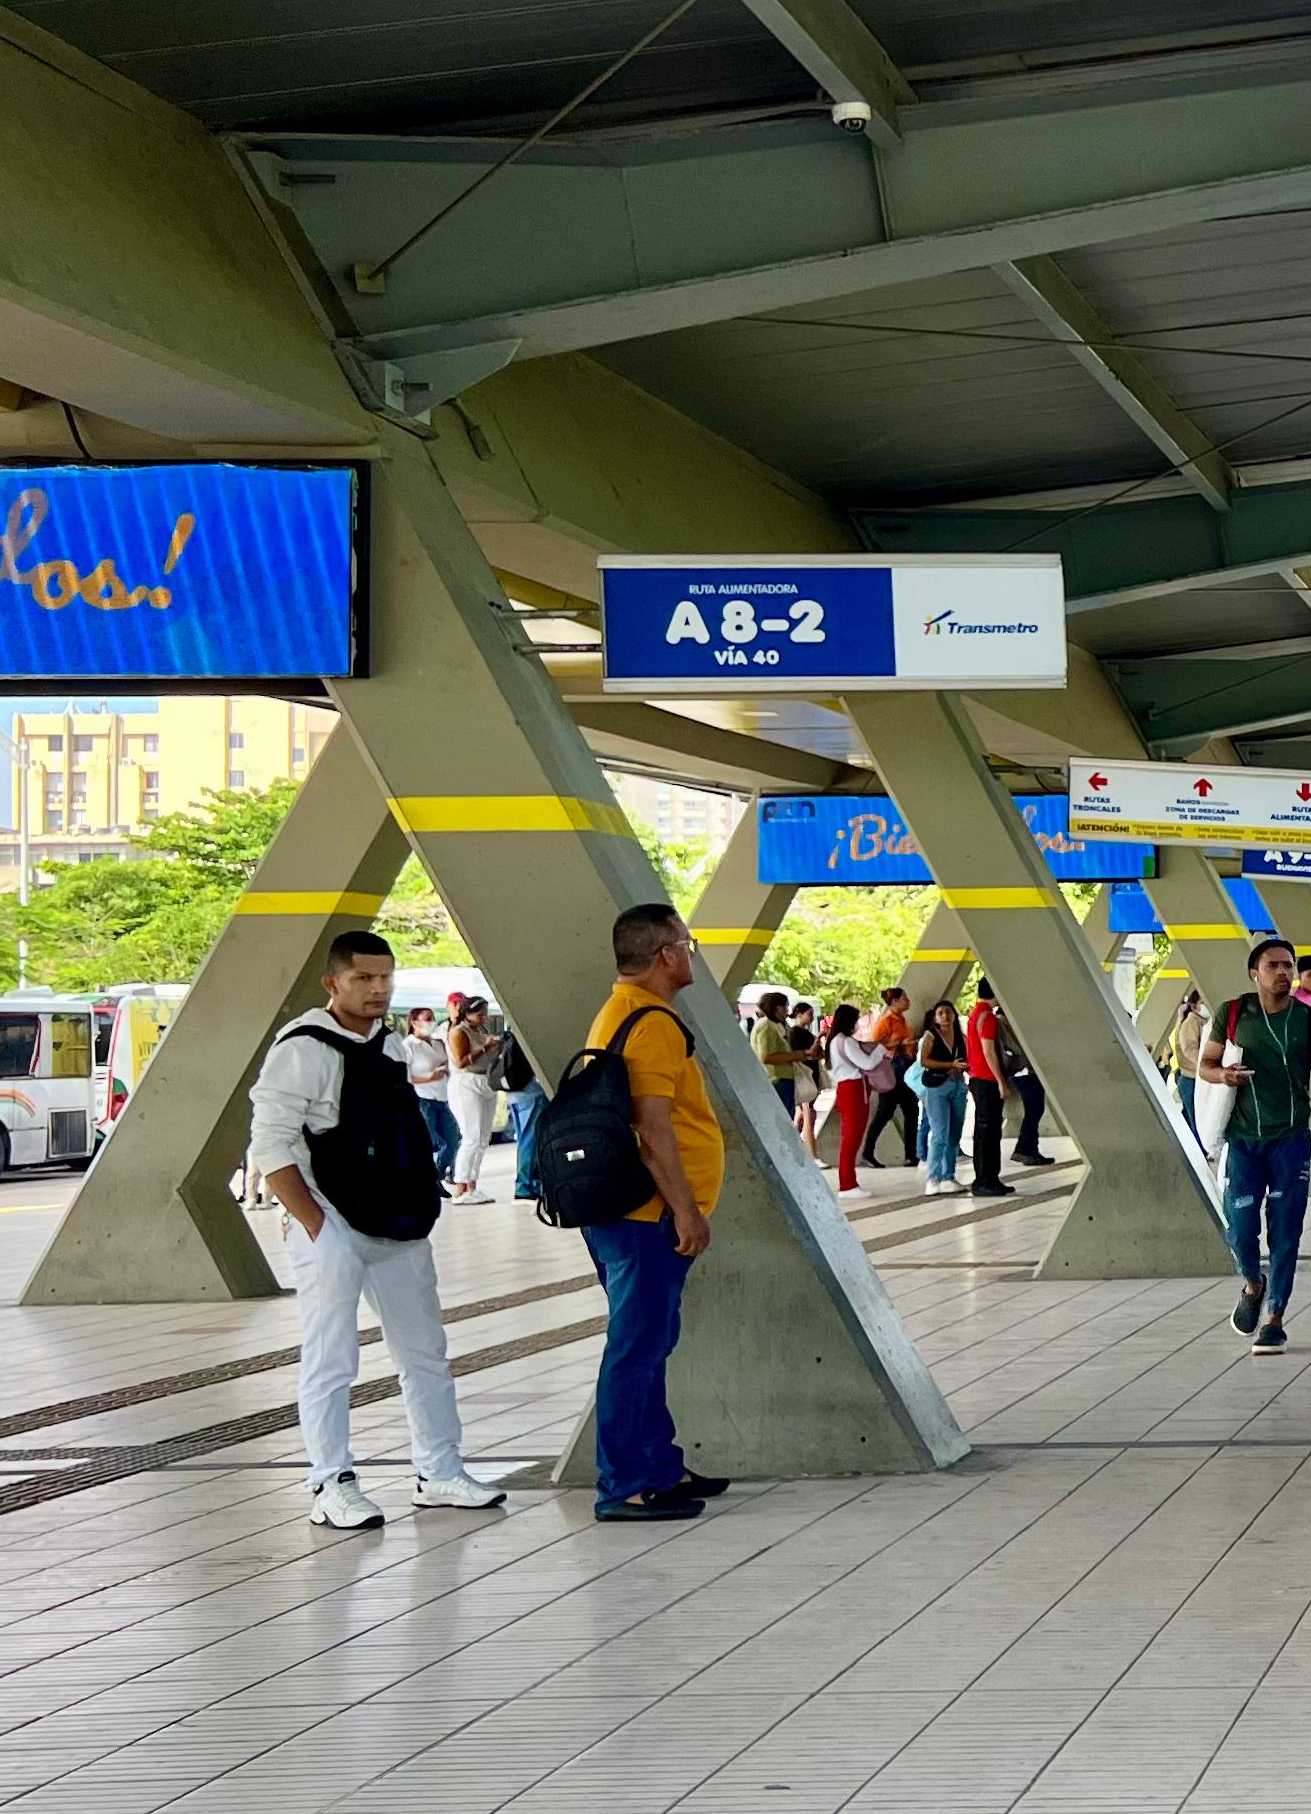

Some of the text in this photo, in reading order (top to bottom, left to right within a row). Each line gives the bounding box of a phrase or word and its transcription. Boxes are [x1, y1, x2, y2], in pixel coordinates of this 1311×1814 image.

[689, 584, 799, 595] RUTA ALIMENTADORA
[665, 599, 826, 645] A 8-2
[947, 622, 1039, 634] Transmetro
[714, 645, 780, 665] VÍA 40
[1083, 796, 1111, 804] RUTAS
[1072, 804, 1121, 813] TRONCALES
